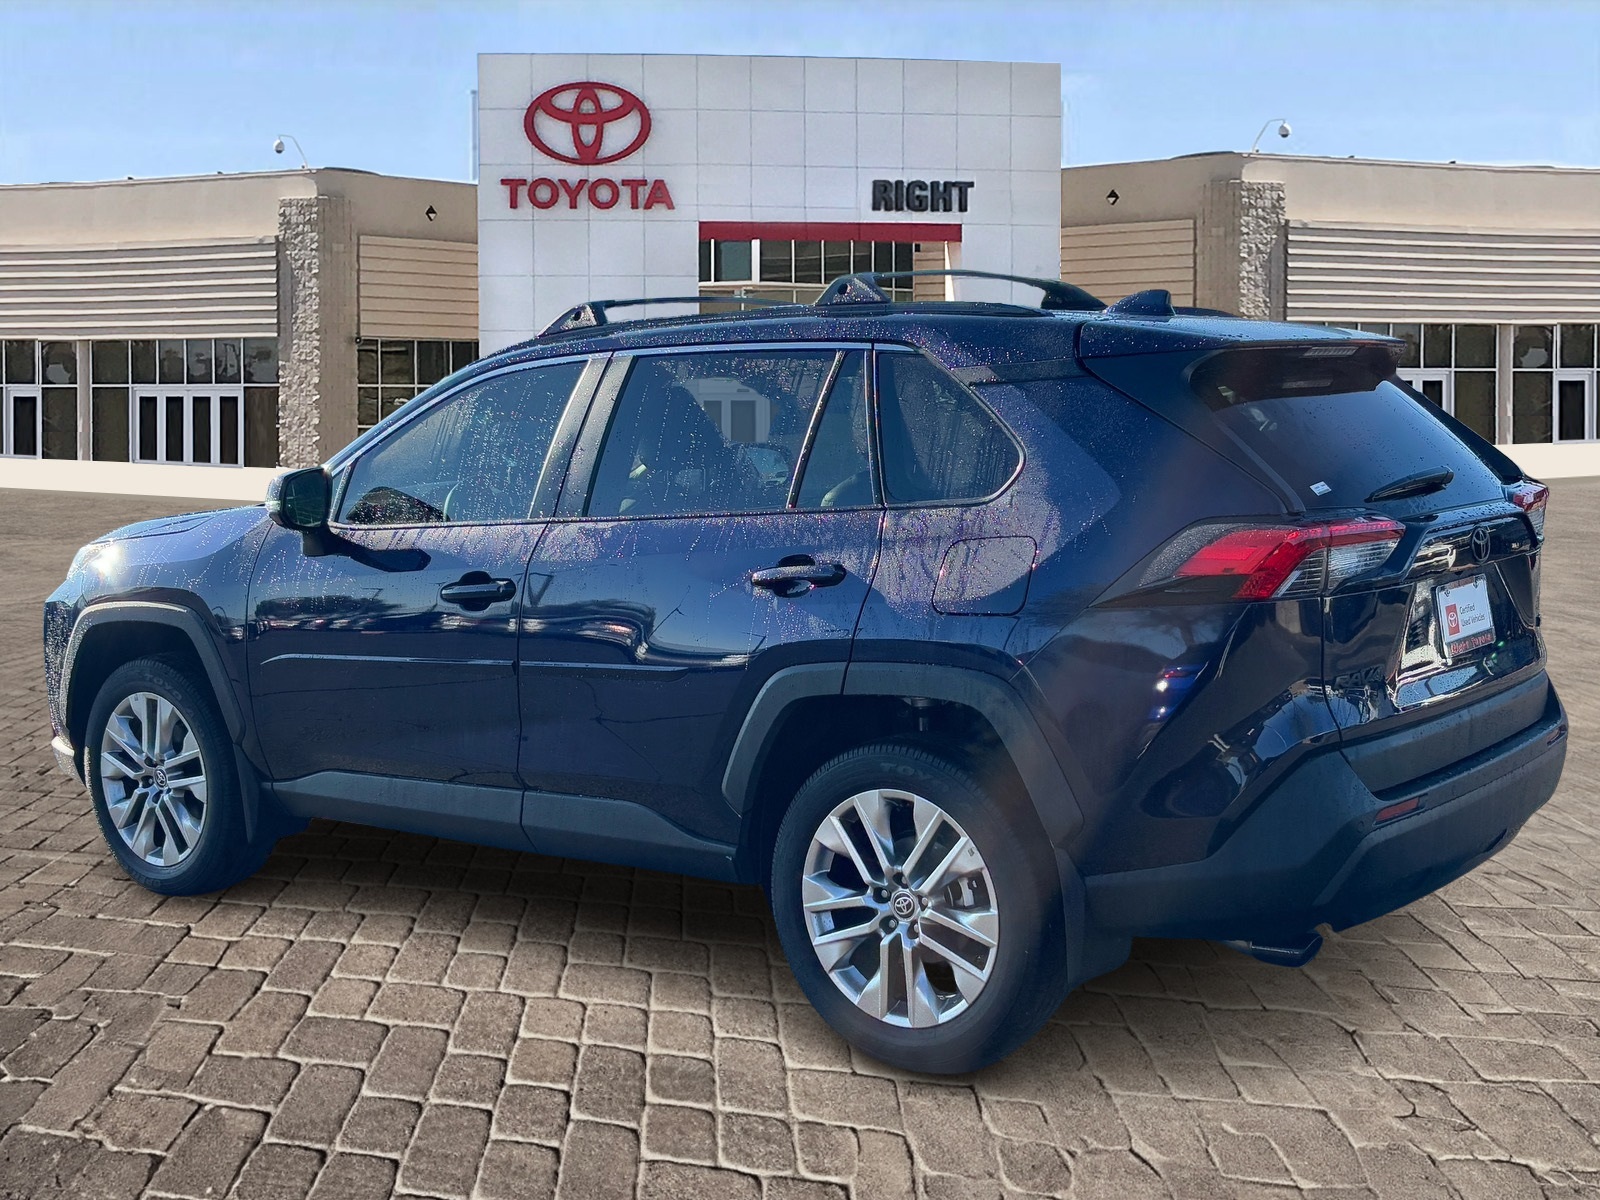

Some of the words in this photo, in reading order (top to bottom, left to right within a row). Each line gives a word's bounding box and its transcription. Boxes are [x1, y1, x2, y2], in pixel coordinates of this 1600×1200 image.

[500, 177, 676, 210] TOYOTA
[871, 179, 975, 212] RIGHT
[1459, 603, 1475, 615] Certified
